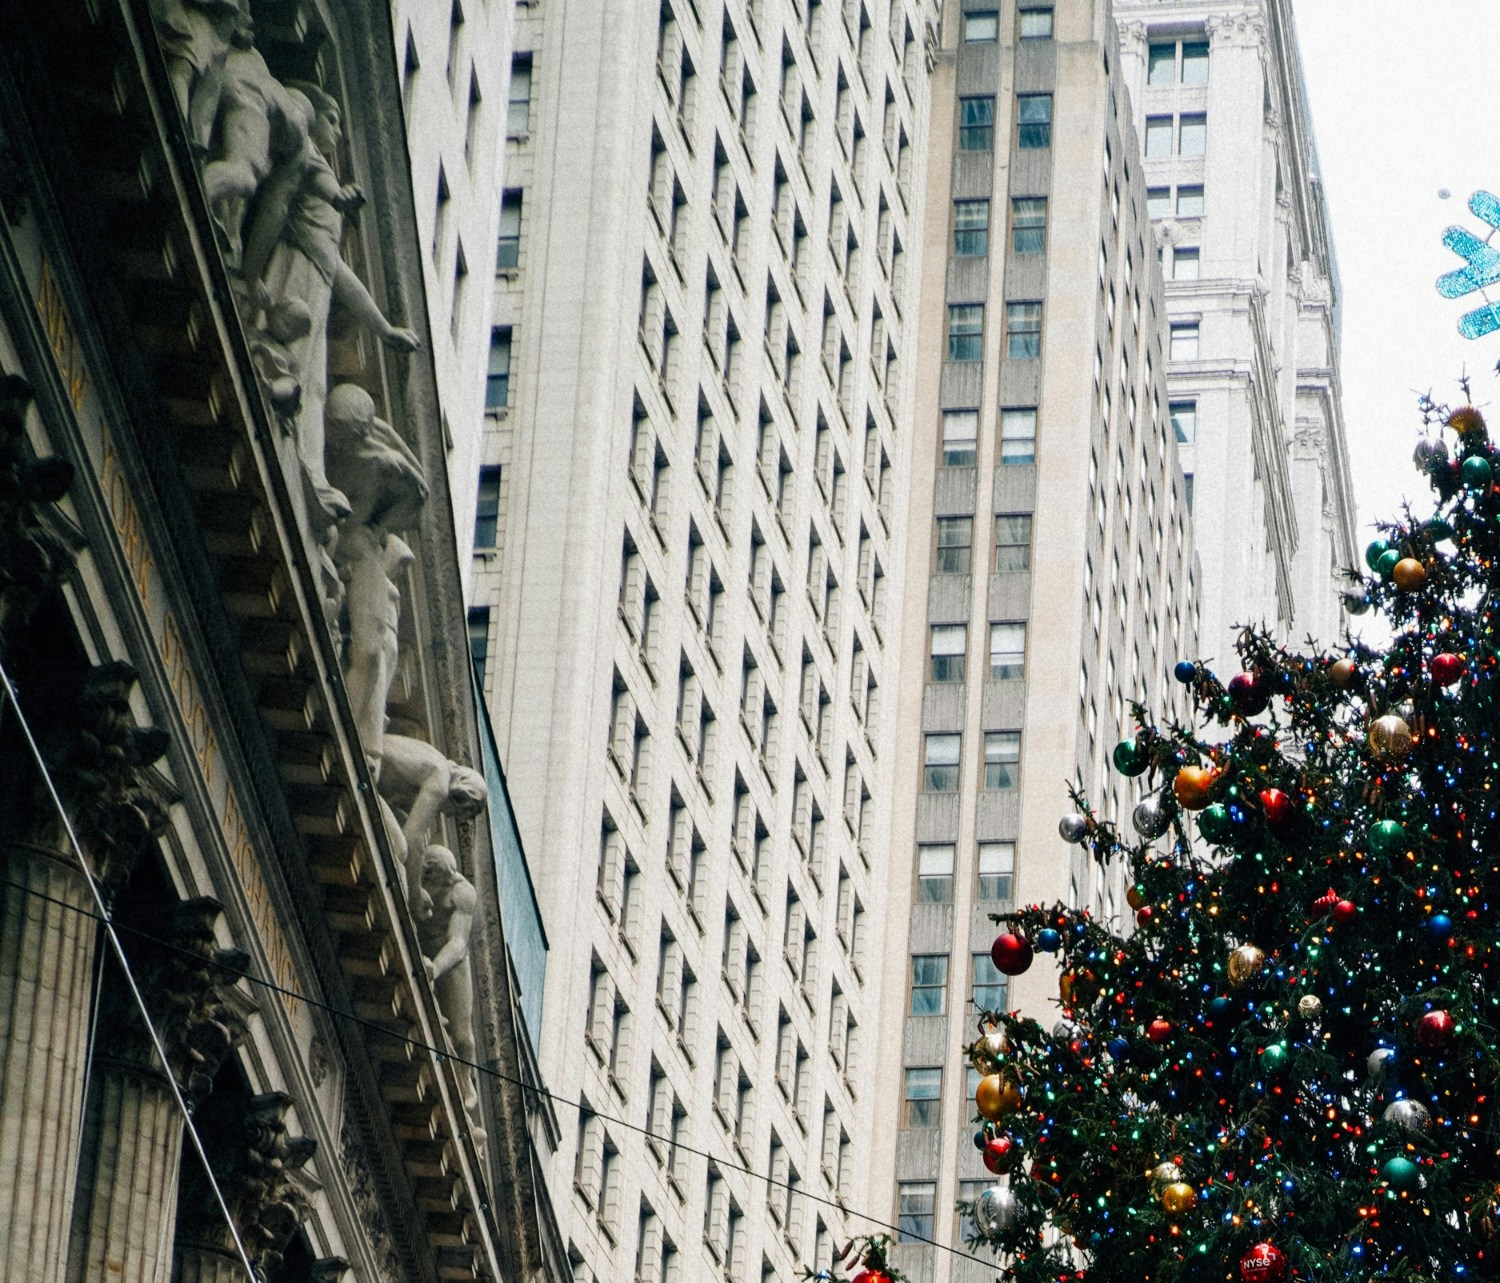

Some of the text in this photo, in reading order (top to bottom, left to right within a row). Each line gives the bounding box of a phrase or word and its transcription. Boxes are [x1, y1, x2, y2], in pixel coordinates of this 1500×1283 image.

[38, 251, 91, 410] NEW
[101, 420, 154, 605] YORK
[160, 611, 216, 783] STOCK
